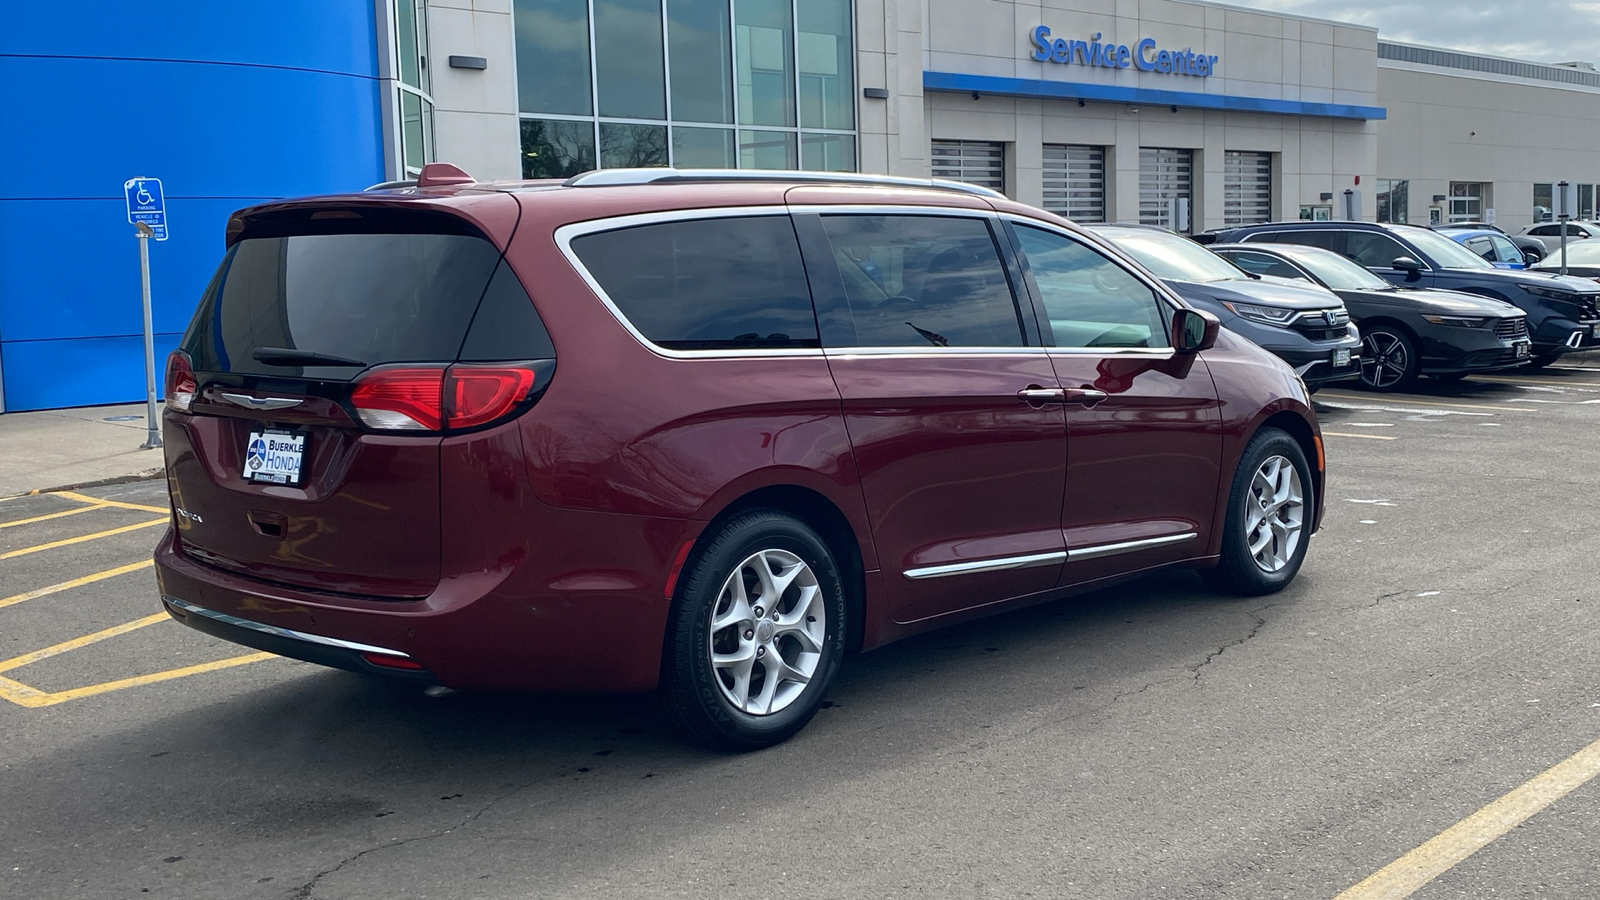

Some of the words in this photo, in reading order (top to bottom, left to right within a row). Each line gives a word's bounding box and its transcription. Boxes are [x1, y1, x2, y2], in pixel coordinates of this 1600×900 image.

[1030, 25, 1130, 69] Service
[1133, 38, 1218, 76] Center
[266, 452, 300, 471] HONDA
[269, 440, 303, 453] BUERKLE
[834, 579, 845, 650] YOKOHAMA
